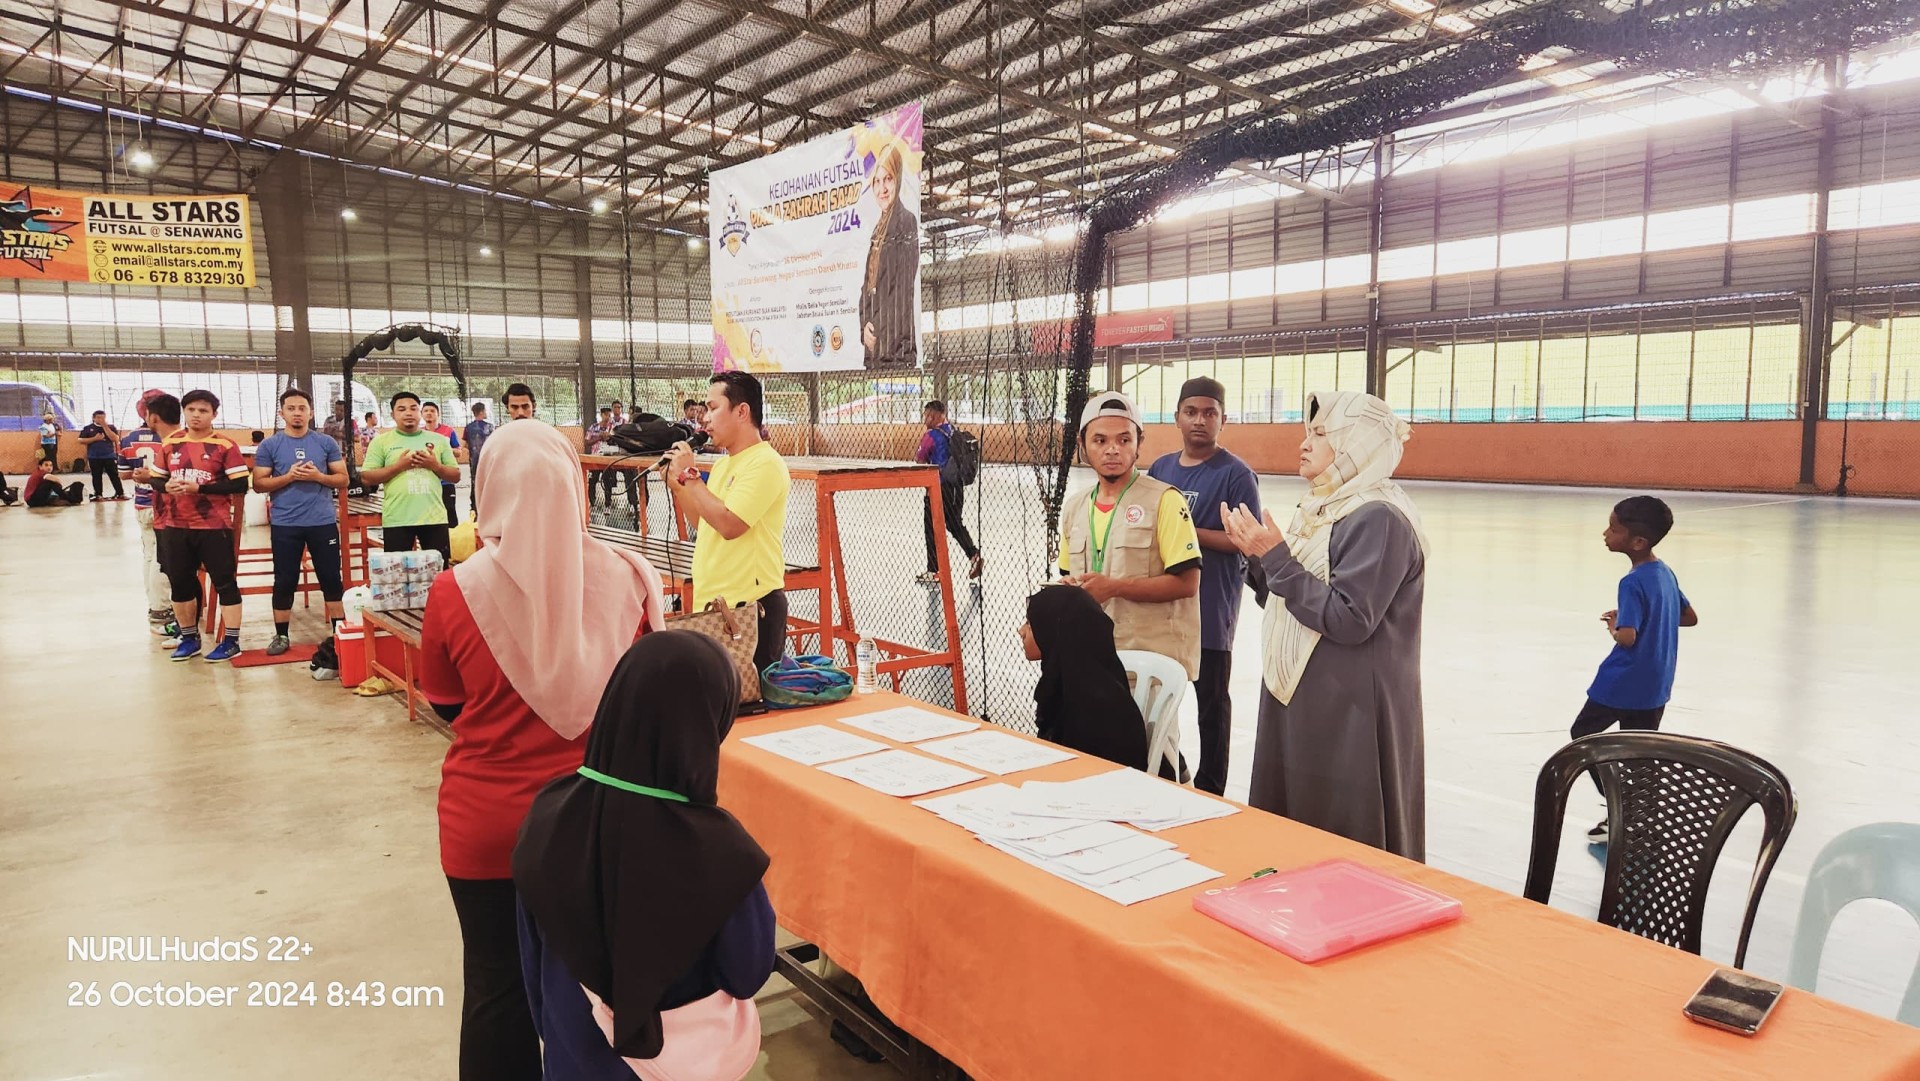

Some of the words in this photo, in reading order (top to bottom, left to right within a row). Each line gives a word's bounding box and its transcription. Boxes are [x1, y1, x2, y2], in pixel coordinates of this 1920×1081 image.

[769, 170, 821, 200] KEJOHANAN
[823, 158, 863, 185] FUTSAL
[88, 201, 143, 220] ALL
[152, 201, 240, 223] STARS
[783, 190, 828, 221] ZAHRAH
[89, 222, 146, 235] FUTSAL
[150, 226, 160, 237] @
[164, 226, 243, 238] SENAWANG
[828, 208, 860, 234] 2024
[1, 229, 71, 252] STARS
[111, 243, 241, 258] www.allstars.com.my
[113, 255, 243, 271] email@allstars.com.my
[114, 269, 134, 282] 06
[149, 270, 178, 283] 678
[184, 272, 245, 285] 8329/30
